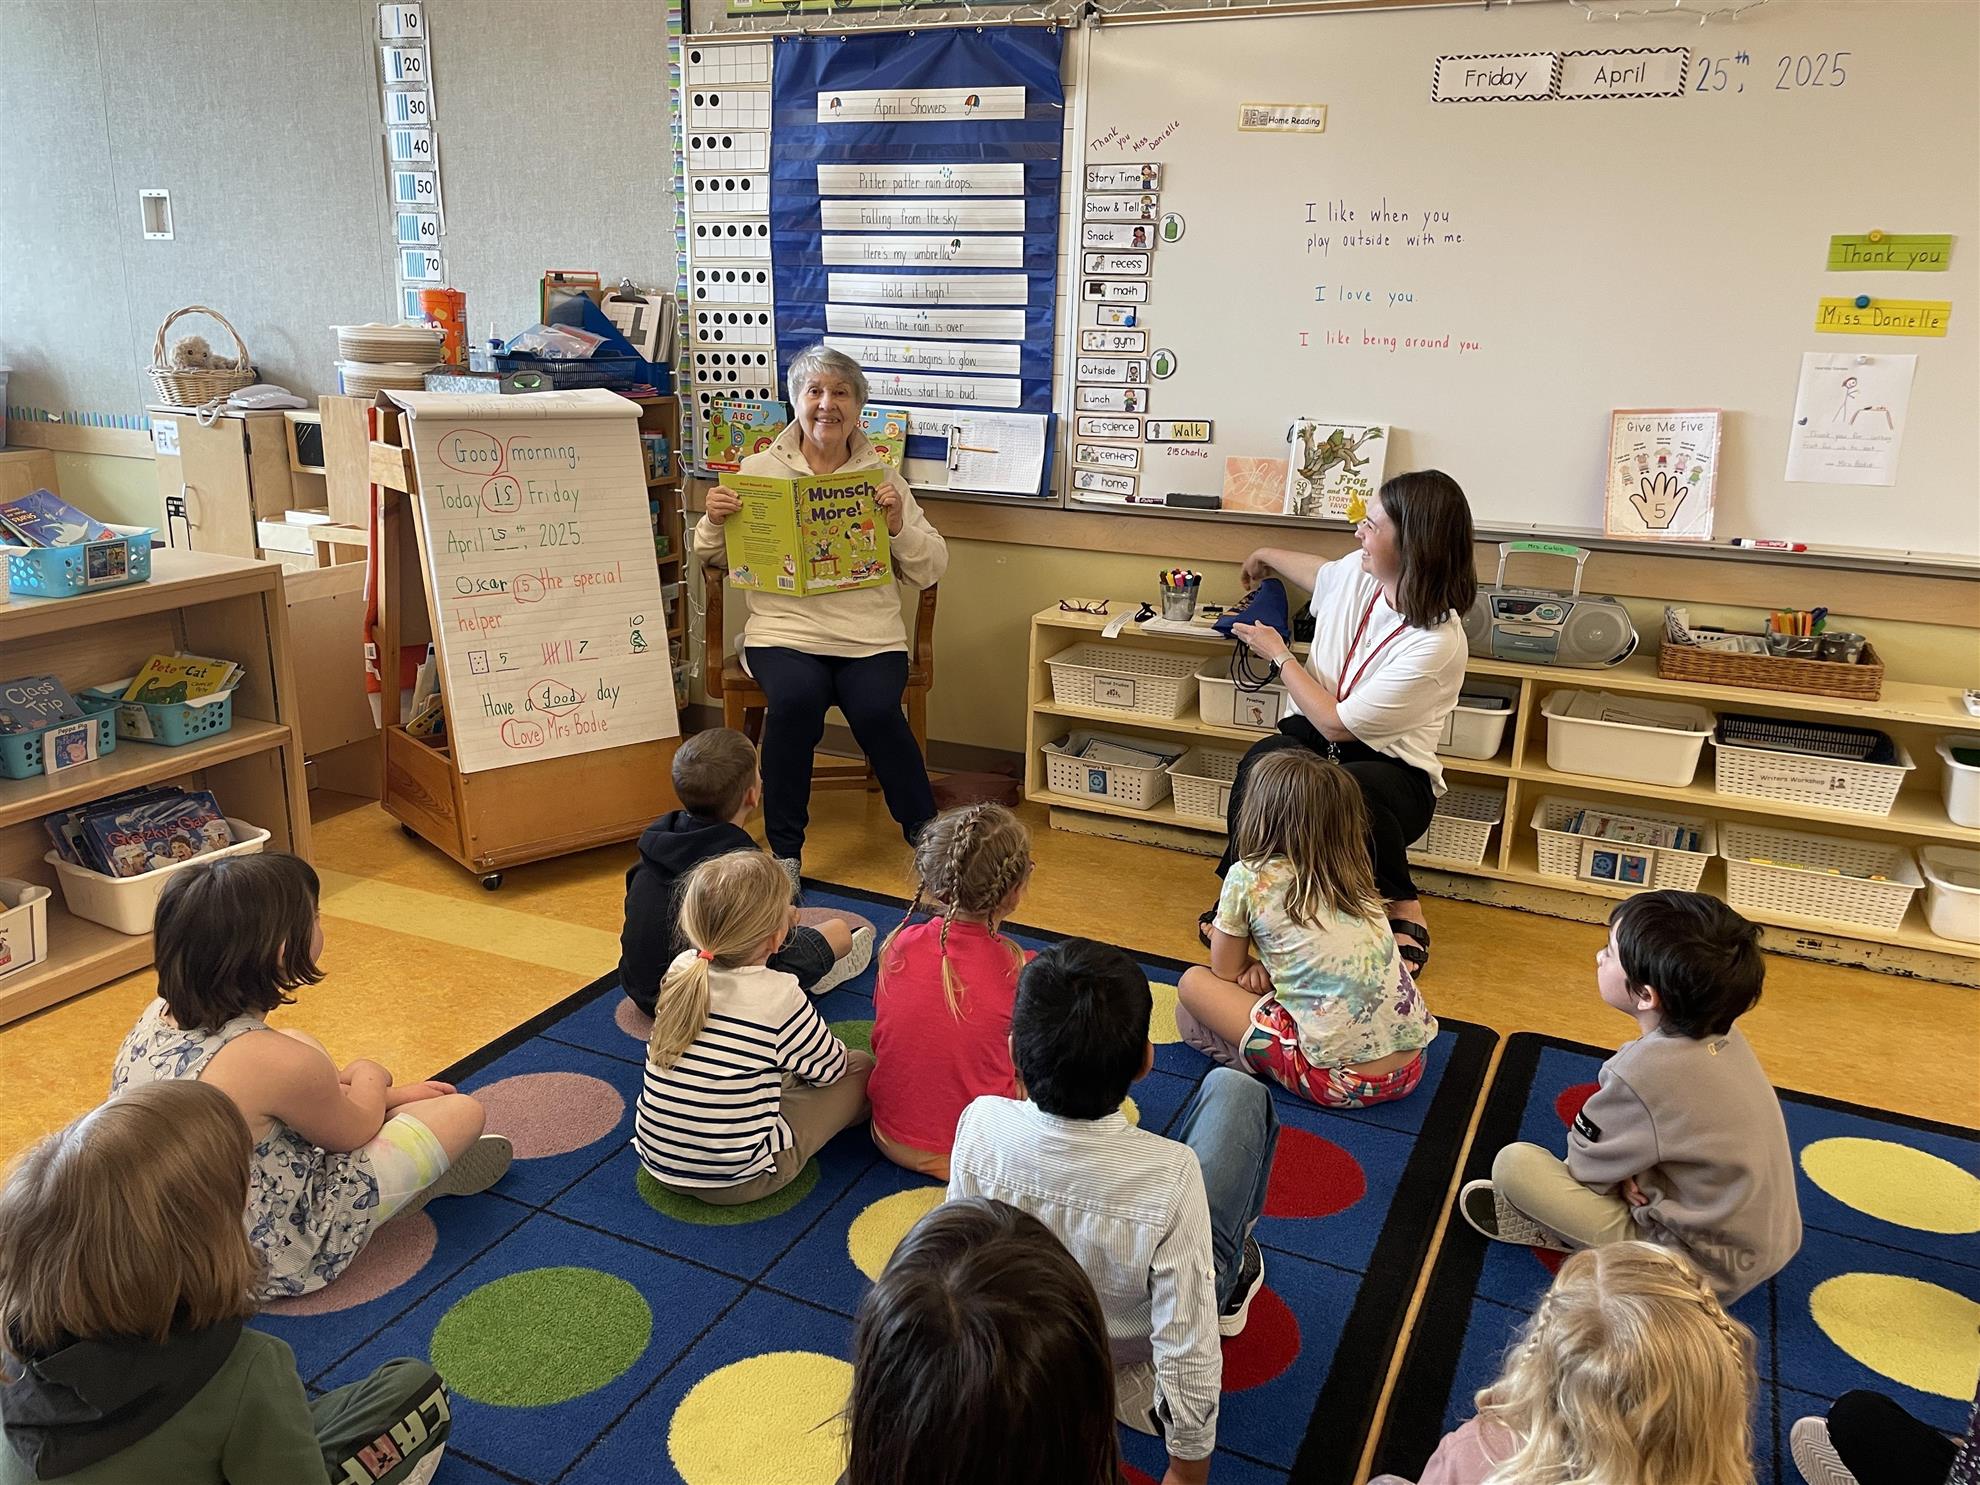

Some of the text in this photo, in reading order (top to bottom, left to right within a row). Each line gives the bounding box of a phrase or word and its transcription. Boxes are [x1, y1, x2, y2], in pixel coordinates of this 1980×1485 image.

[404, 13, 417, 28] 10
[404, 57, 420, 72] 20
[1464, 68, 1528, 90] Friday
[1593, 61, 1645, 89] April
[1776, 52, 1852, 90] 2025
[409, 100, 425, 115] 30
[873, 96, 947, 120] April Showers
[1268, 115, 1321, 128] Home Reading
[1089, 125, 1119, 152] Thank
[1148, 120, 1180, 151] Danielle
[413, 139, 429, 154] 40
[417, 180, 432, 194] 50
[859, 172, 886, 190] Pitter
[893, 173, 920, 194] patter
[925, 179, 941, 190] rain
[1088, 172, 1141, 185] Story Time
[1086, 202, 1140, 213] Show & Tell
[1305, 197, 1449, 232] I like when you
[861, 208, 892, 230] Falling
[901, 208, 922, 226] from
[926, 208, 940, 226] the
[421, 221, 435, 236] 60
[1087, 230, 1114, 241] Snack
[1307, 233, 1330, 257] play
[1342, 229, 1390, 246] outside
[1406, 232, 1435, 247] with
[863, 243, 888, 261] Here's
[893, 250, 906, 266] my
[1841, 243, 1941, 270] Thank you
[425, 258, 440, 271] 70
[1110, 258, 1143, 269] recess
[881, 281, 950, 304] Hold it high!
[1113, 284, 1138, 296] math
[1315, 286, 1326, 302] I
[1339, 285, 1372, 302] love
[863, 312, 965, 334] When the rain is over
[1872, 307, 1939, 329] Danielle
[1113, 335, 1136, 349] gym
[1299, 332, 1309, 346] I
[1326, 330, 1350, 345] like
[1363, 328, 1397, 353] being
[1405, 334, 1450, 349] around
[861, 346, 977, 372] And the sun begins to glow
[1081, 364, 1116, 376] Outside
[881, 380, 912, 397] flowers
[918, 383, 938, 398] start
[945, 383, 954, 399] to
[1083, 393, 1110, 404] Lunch
[731, 411, 753, 421] ABC
[941, 422, 954, 436] gro
[1101, 421, 1135, 433] science
[1173, 423, 1202, 438] Walk
[1627, 421, 1704, 433] Give Me Five
[454, 438, 498, 463] Good
[1099, 450, 1136, 463] centers
[1100, 477, 1129, 490] home
[1335, 474, 1368, 487] Frog
[435, 480, 580, 518] Today is Friday
[808, 481, 876, 501] Munsch
[811, 500, 863, 522] More!
[1653, 502, 1666, 519] 5
[447, 528, 485, 562] April
[456, 575, 508, 595] Oscar
[539, 568, 563, 591] the
[573, 561, 623, 593] special
[629, 614, 645, 628] 10
[499, 640, 589, 665] 5 7
[150, 660, 178, 674] Pete
[184, 665, 209, 679] Cat
[5, 681, 55, 705] Class
[481, 677, 620, 718] Have a good day
[25, 699, 64, 717] Trip
[57, 722, 88, 736] Peppa Pig
[511, 714, 608, 746] Love Mrs Bodie
[1760, 775, 1825, 786] Writers Workshop
